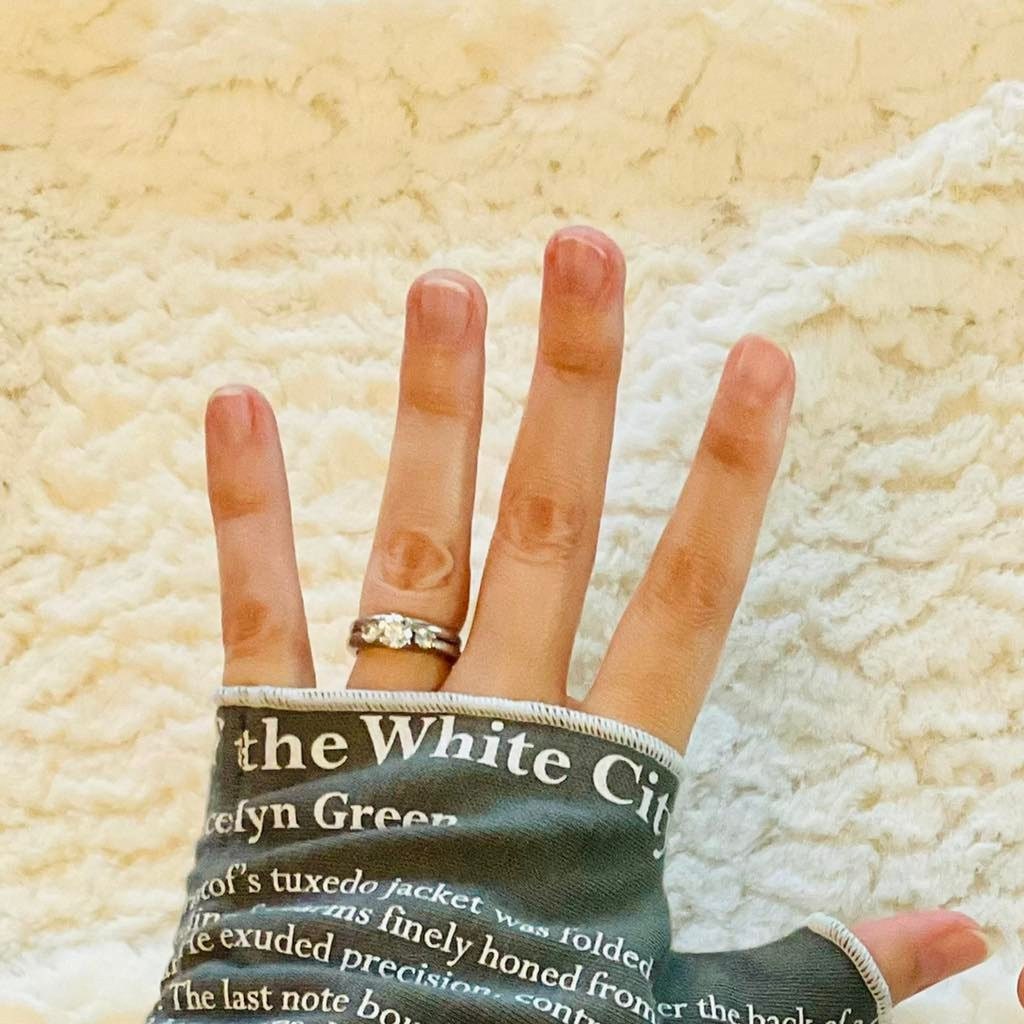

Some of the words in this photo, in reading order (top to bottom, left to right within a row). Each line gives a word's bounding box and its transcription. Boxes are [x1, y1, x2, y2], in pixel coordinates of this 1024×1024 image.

[234, 716, 349, 772] the
[360, 714, 571, 785] White
[220, 924, 335, 963] exuded
[270, 868, 378, 895] tuxedo
[378, 877, 484, 914] jacket
[495, 908, 549, 938] was
[560, 927, 654, 980] folded
[377, 904, 473, 967] finely
[479, 935, 583, 992] honed
[168, 979, 217, 1012] The
[221, 978, 273, 1011] last
[281, 987, 350, 1013] note
